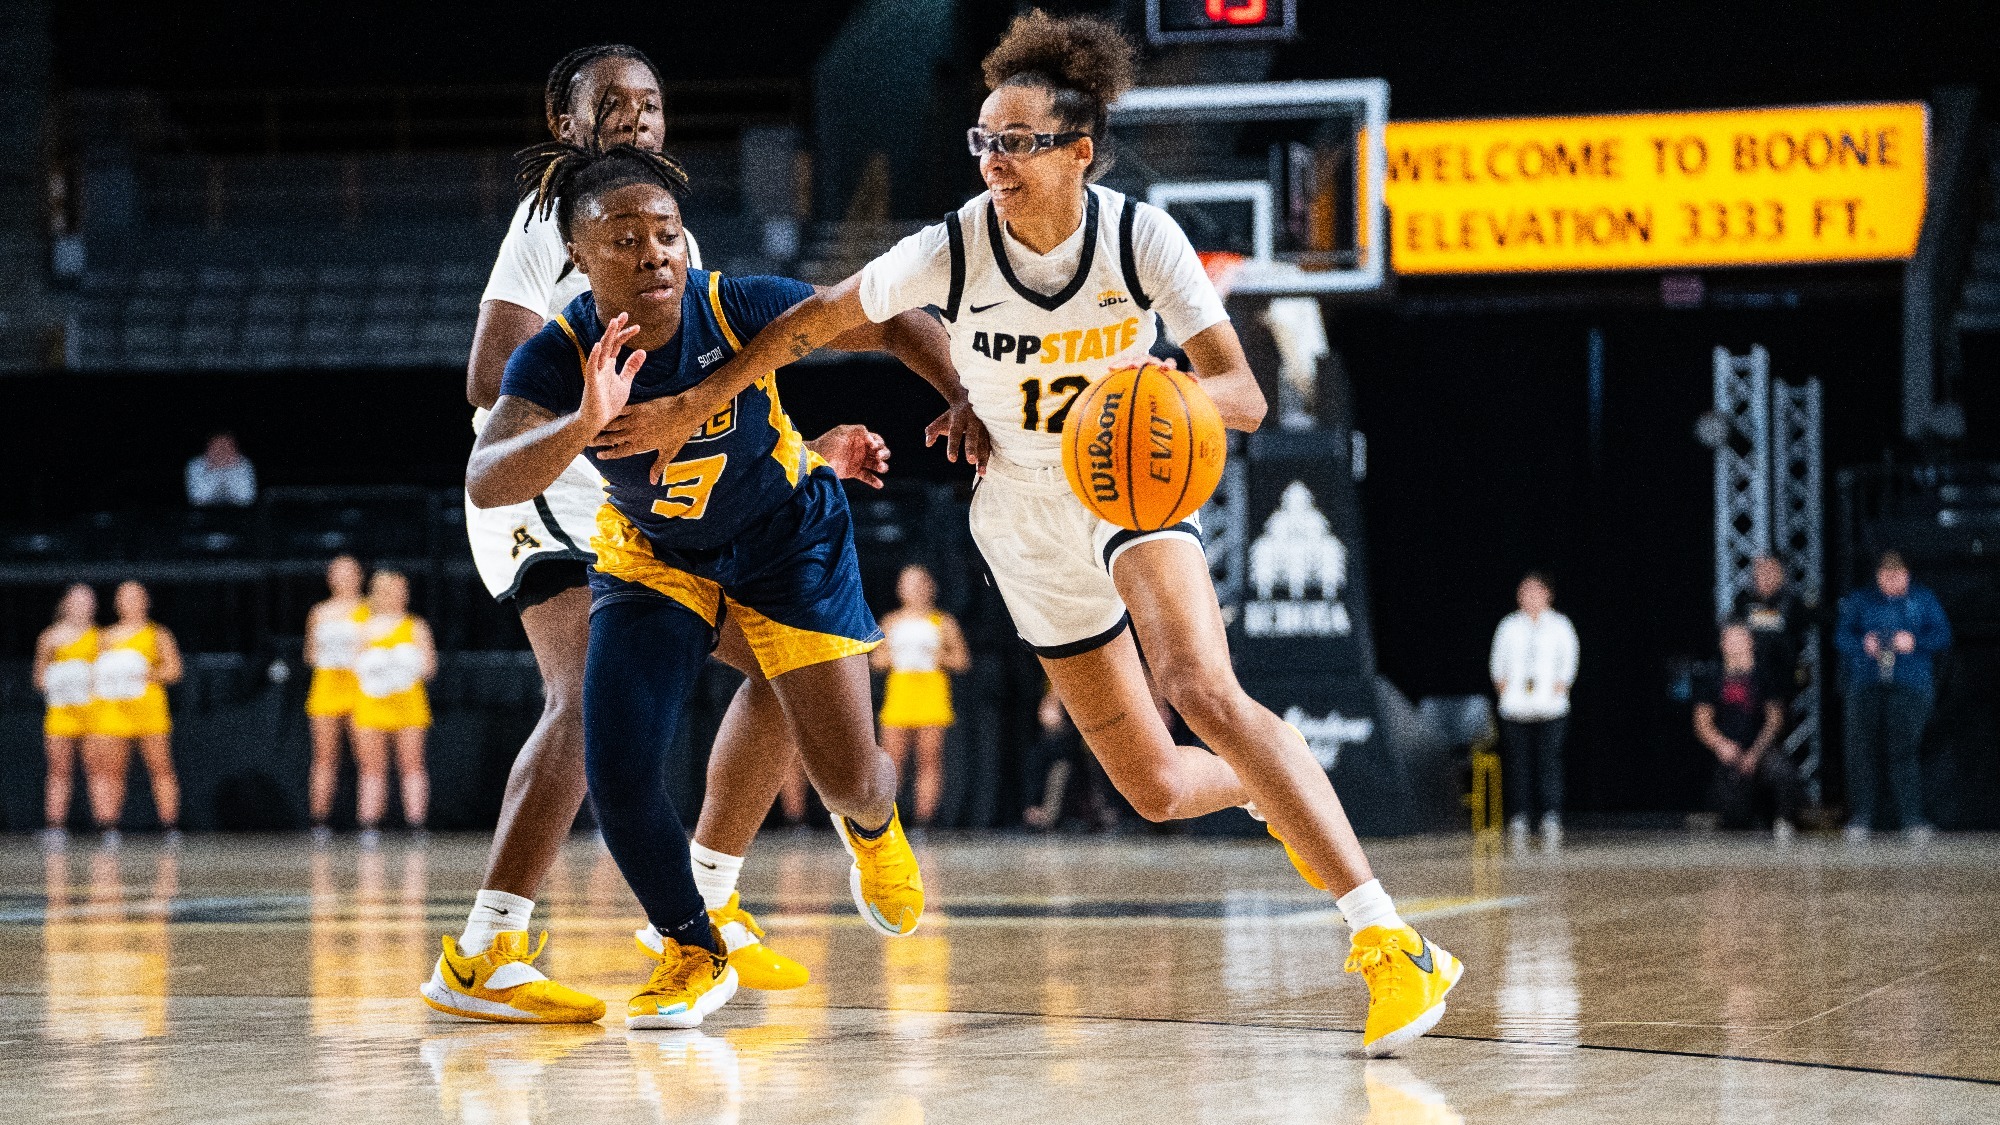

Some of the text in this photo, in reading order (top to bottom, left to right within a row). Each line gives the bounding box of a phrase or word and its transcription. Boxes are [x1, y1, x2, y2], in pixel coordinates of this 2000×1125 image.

[1386, 126, 1900, 182] WELCOME TO BOONE
[1406, 197, 1878, 252] ELEVATION 3333 FT.
[697, 346, 724, 369] SOCON
[1020, 374, 1093, 434] 12
[1088, 389, 1125, 502] Wilson
[651, 452, 728, 520] 3
